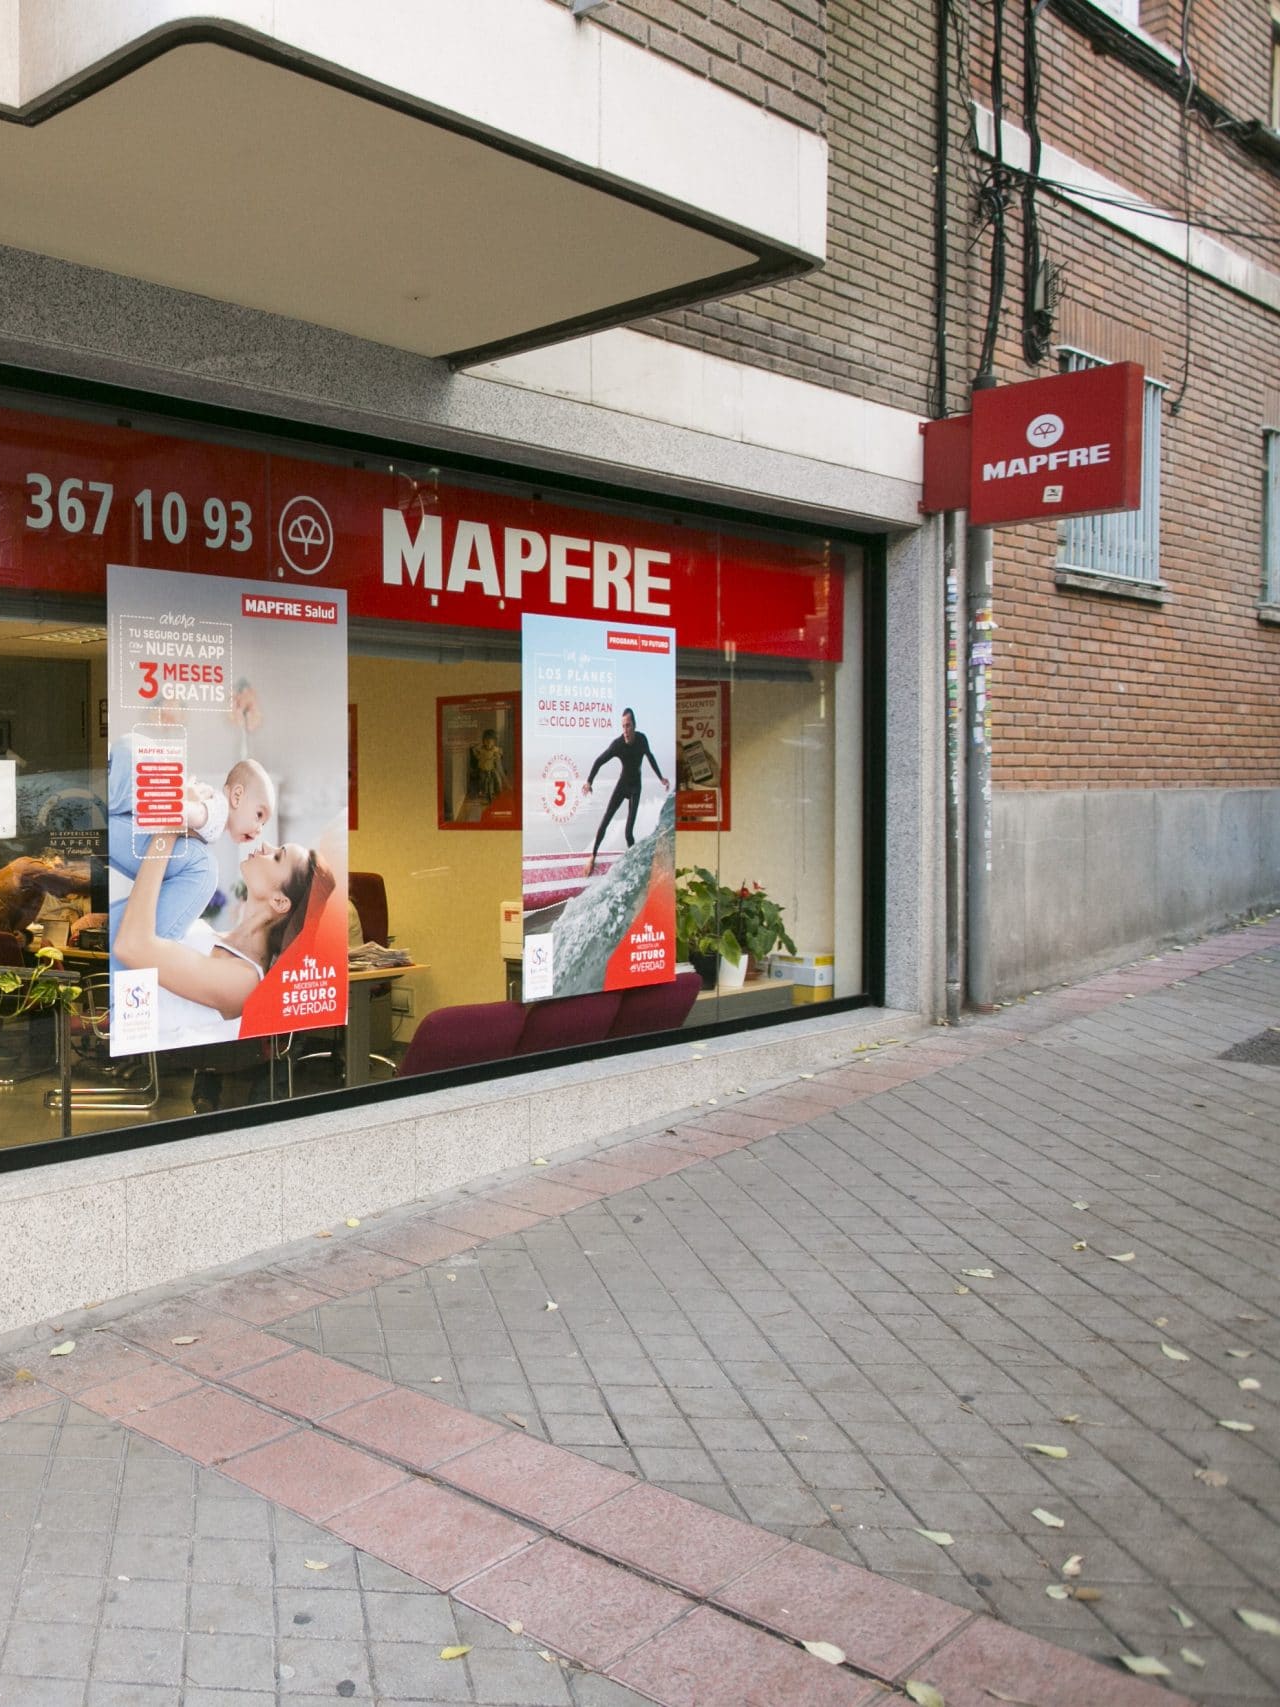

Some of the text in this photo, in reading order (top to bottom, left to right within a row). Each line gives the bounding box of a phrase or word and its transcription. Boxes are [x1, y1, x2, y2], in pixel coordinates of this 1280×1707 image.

[982, 443, 1111, 482] MAPFRE
[25, 473, 114, 535] 367
[134, 489, 188, 545] 10
[202, 497, 254, 552] 93
[382, 507, 671, 617] MAPFRE
[245, 598, 336, 620] MAPFRE Salud
[159, 611, 197, 628] ahora
[128, 628, 225, 644] TU SEGURO DE SALUD
[146, 641, 196, 658] NUEVA
[198, 645, 225, 660] APP
[129, 661, 159, 699] Y 3
[163, 662, 224, 684] MESES
[538, 665, 614, 684] LOS PLANES
[162, 682, 226, 703] GRATIS
[549, 684, 614, 700] PENSIONES
[538, 699, 613, 713] QUE SE ADAPTAN
[550, 716, 576, 727] CICLO
[578, 717, 590, 728] DE
[592, 718, 613, 728] VIDA
[138, 747, 164, 755] MAPFRE
[630, 931, 666, 945] FAMILIA
[303, 954, 317, 969] tu
[630, 948, 666, 962] FUTURO
[282, 965, 337, 984] FAMILIA
[638, 960, 666, 973] VERDAD
[282, 986, 337, 1005] SEGURO
[292, 999, 337, 1016] VERDAD
